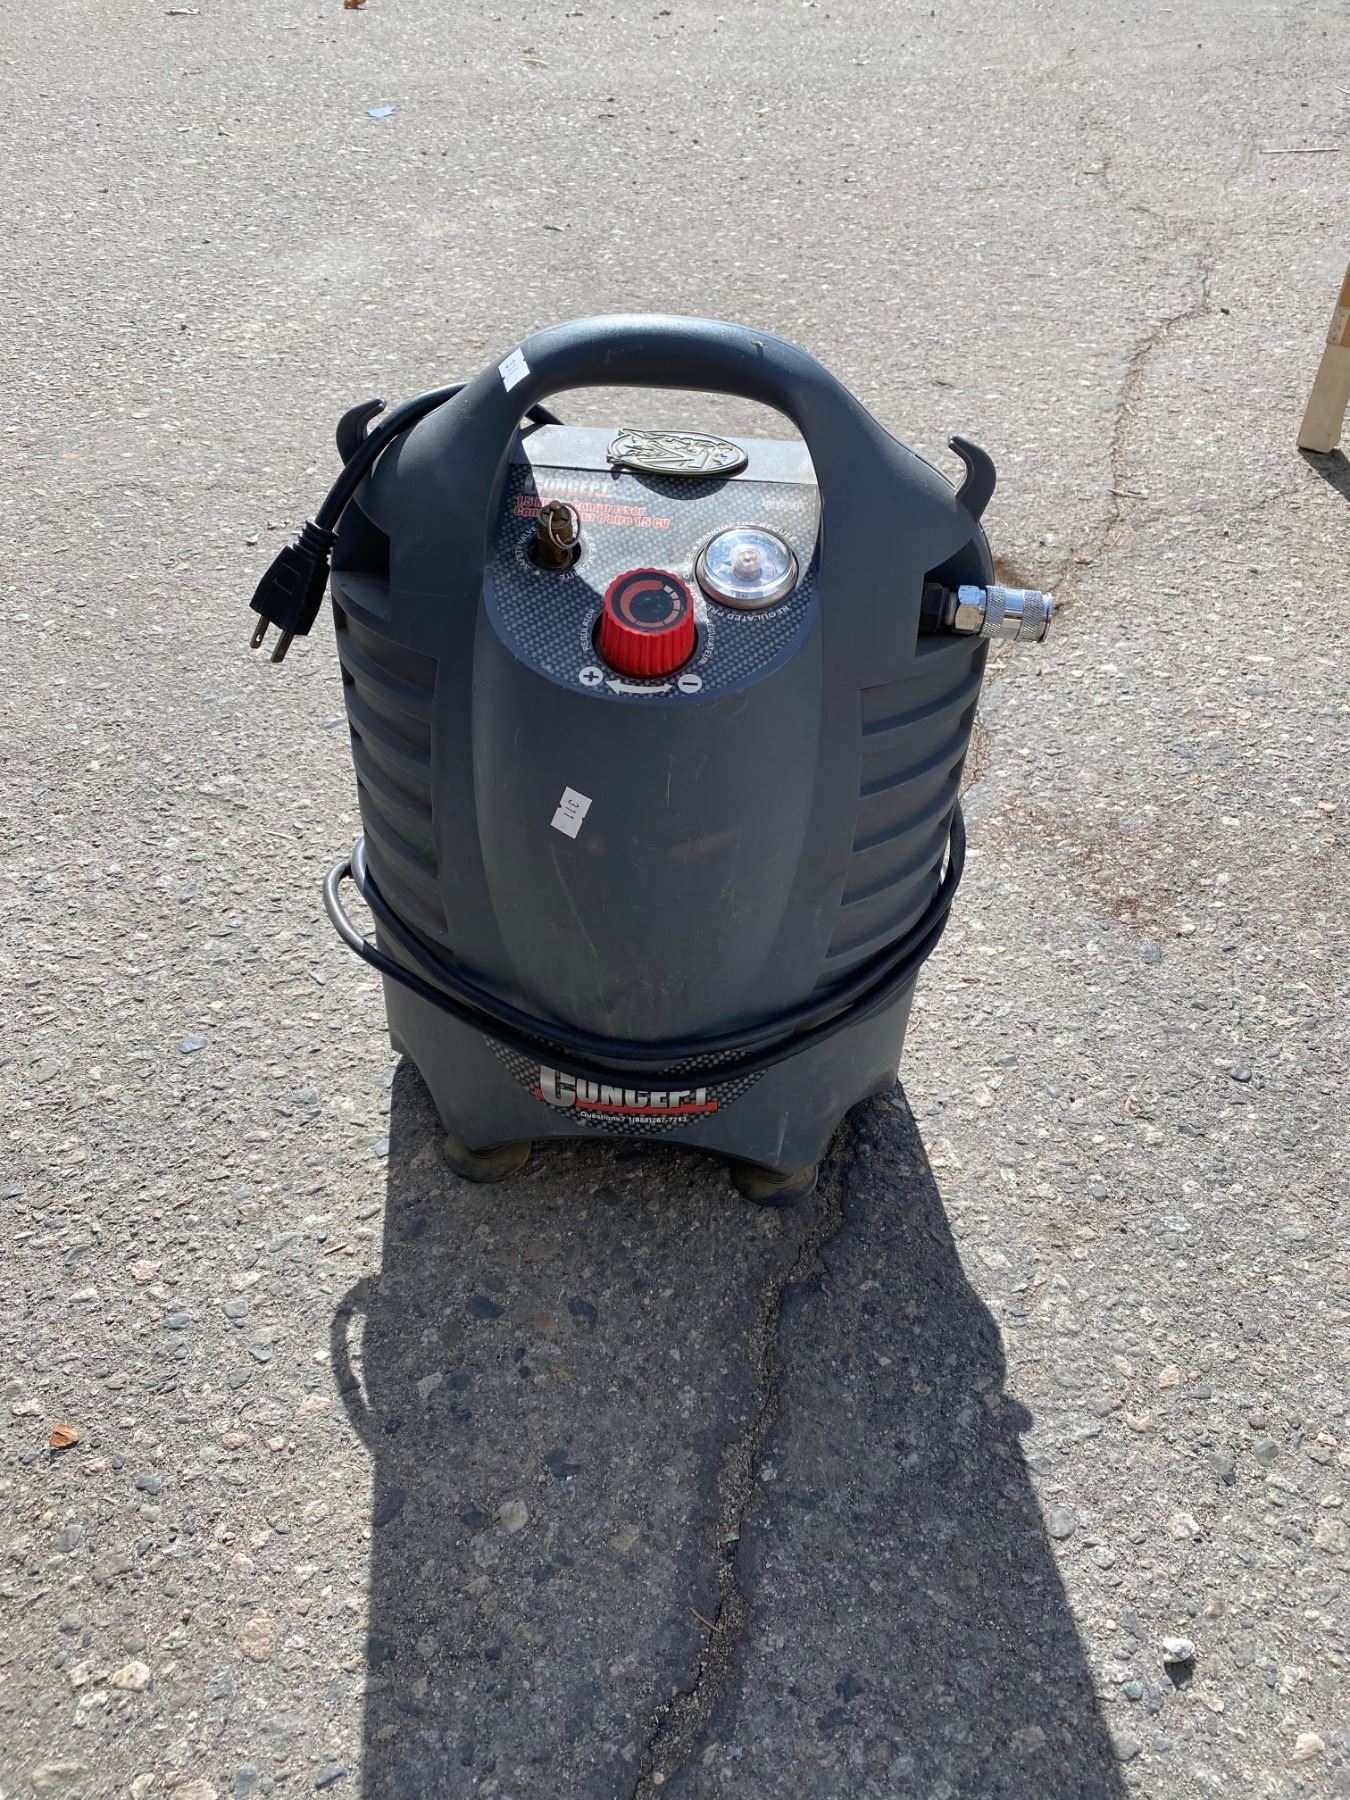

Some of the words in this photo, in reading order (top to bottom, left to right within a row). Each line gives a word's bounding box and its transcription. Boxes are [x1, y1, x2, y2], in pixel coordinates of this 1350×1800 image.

[517, 526, 538, 545] VALVE
[726, 605, 793, 621] REGULATED
[580, 608, 597, 651] REGULATOR
